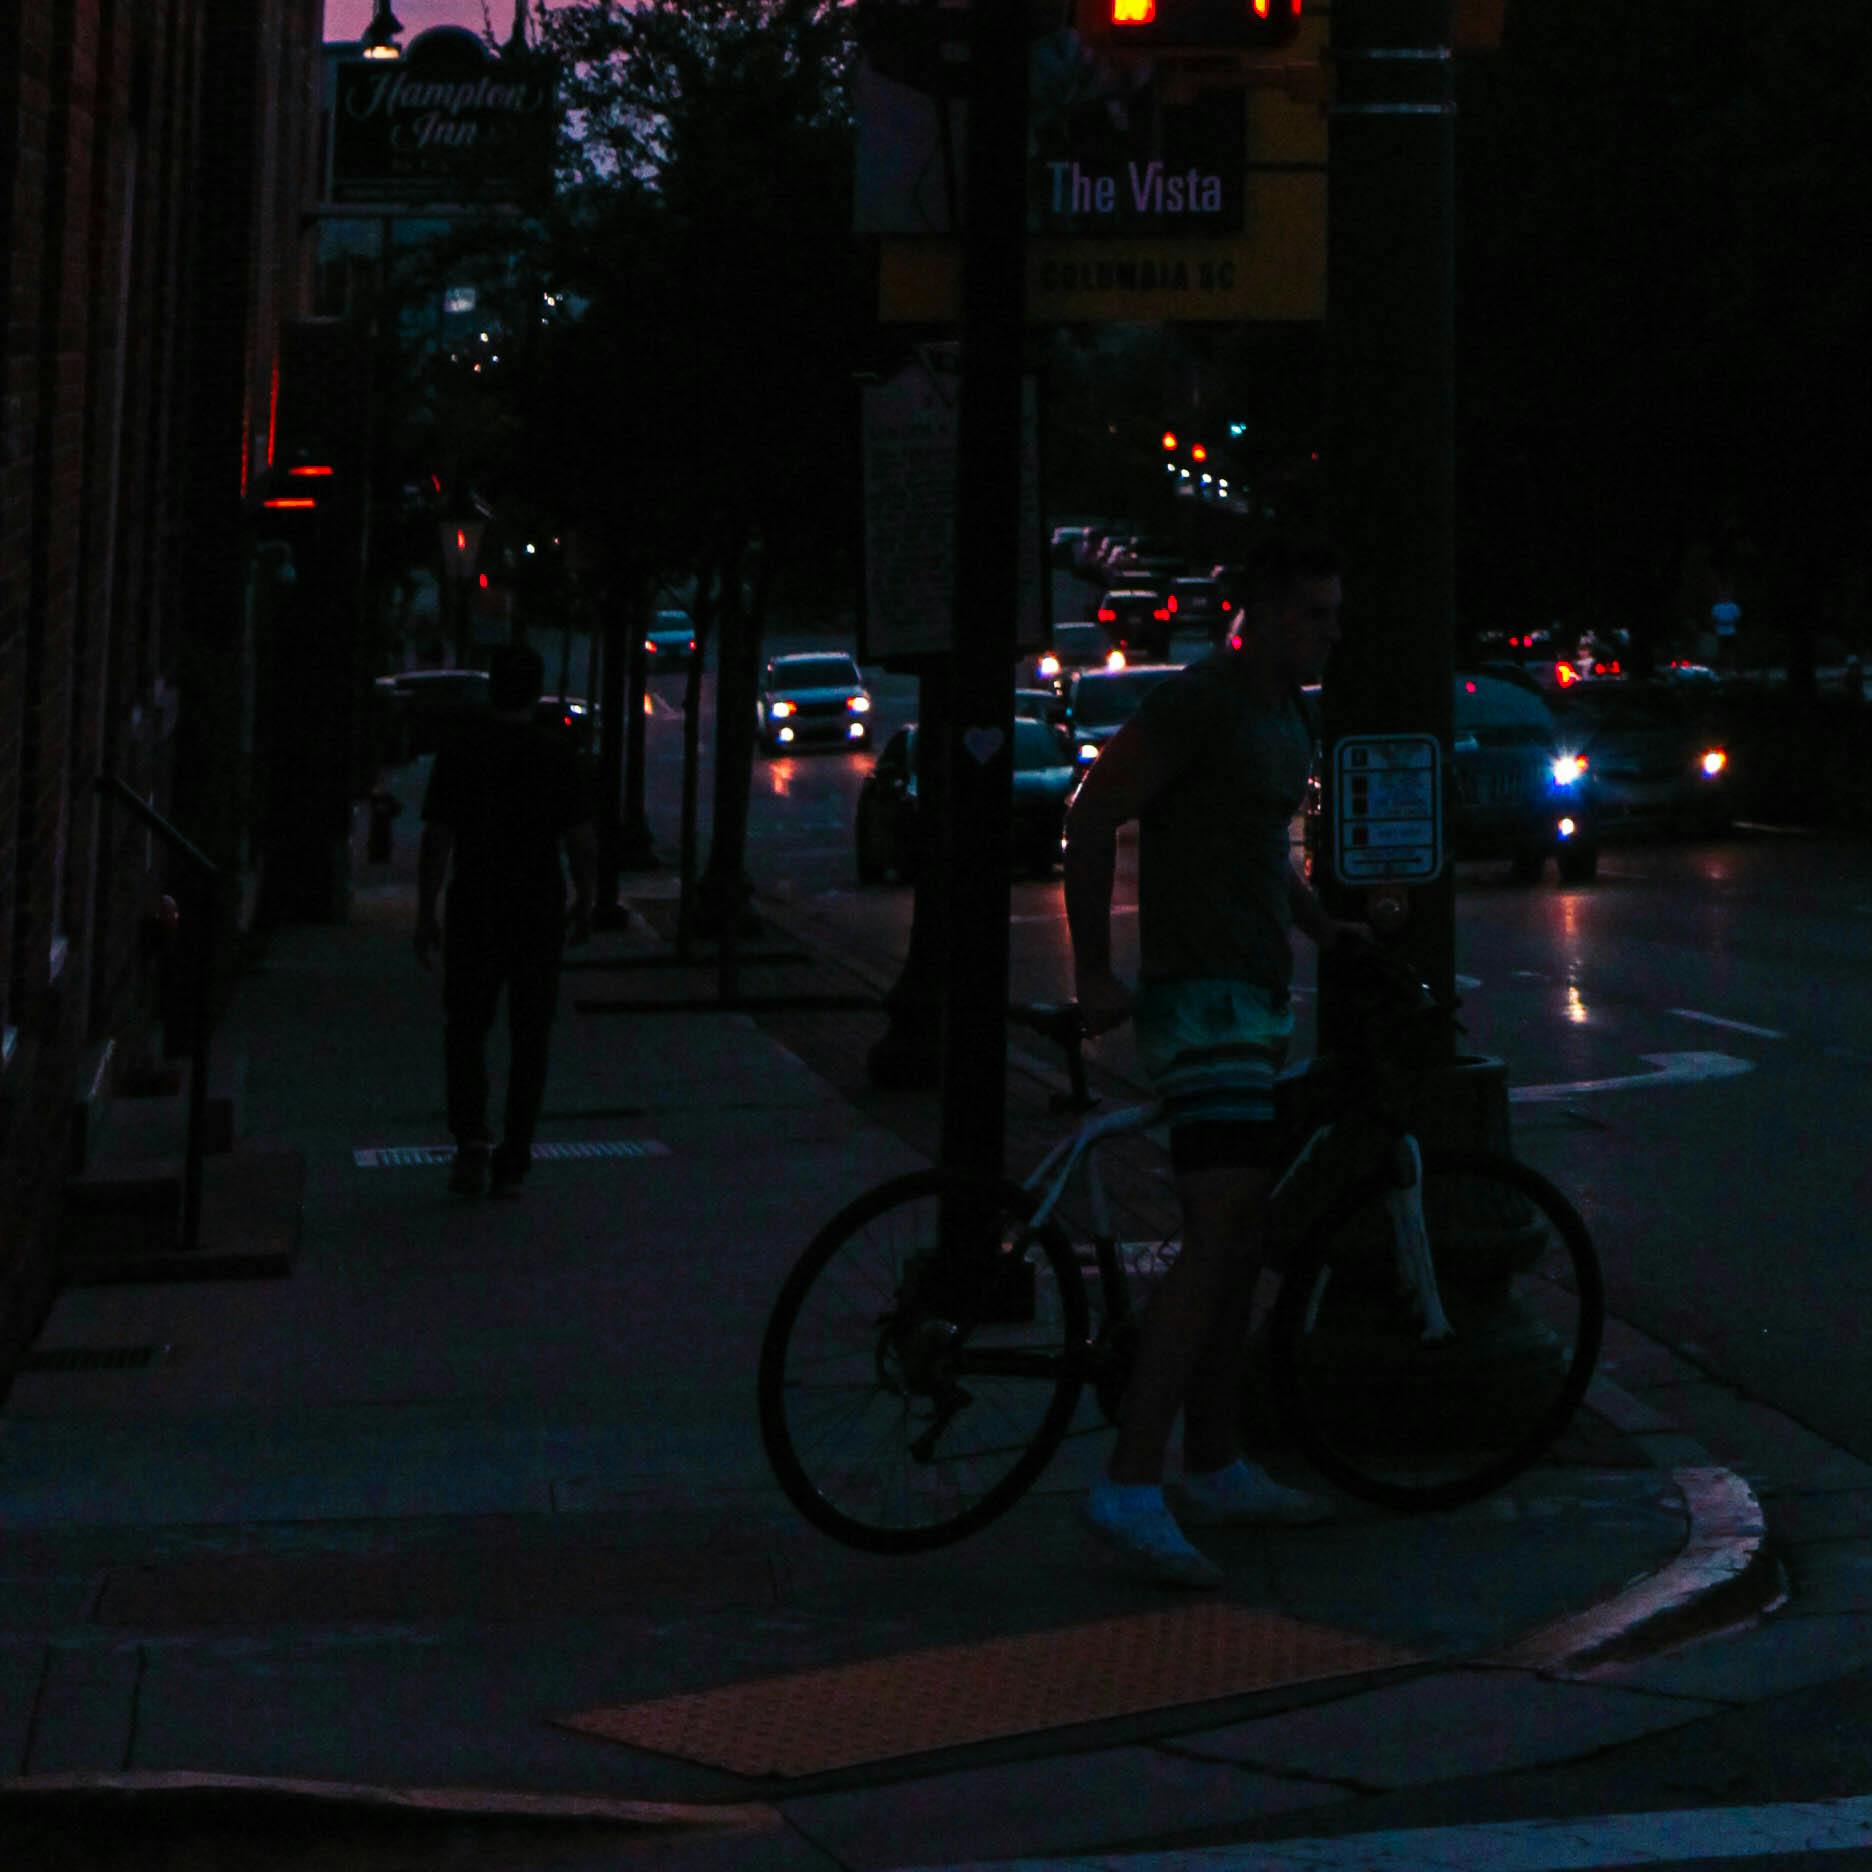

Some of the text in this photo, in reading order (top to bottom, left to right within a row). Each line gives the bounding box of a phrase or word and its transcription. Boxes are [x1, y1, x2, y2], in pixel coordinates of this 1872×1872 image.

[345, 70, 545, 120] Hampton
[390, 110, 482, 150] Inn
[1048, 159, 1225, 214] The Vista
[1040, 259, 1189, 292] COLUMBIA
